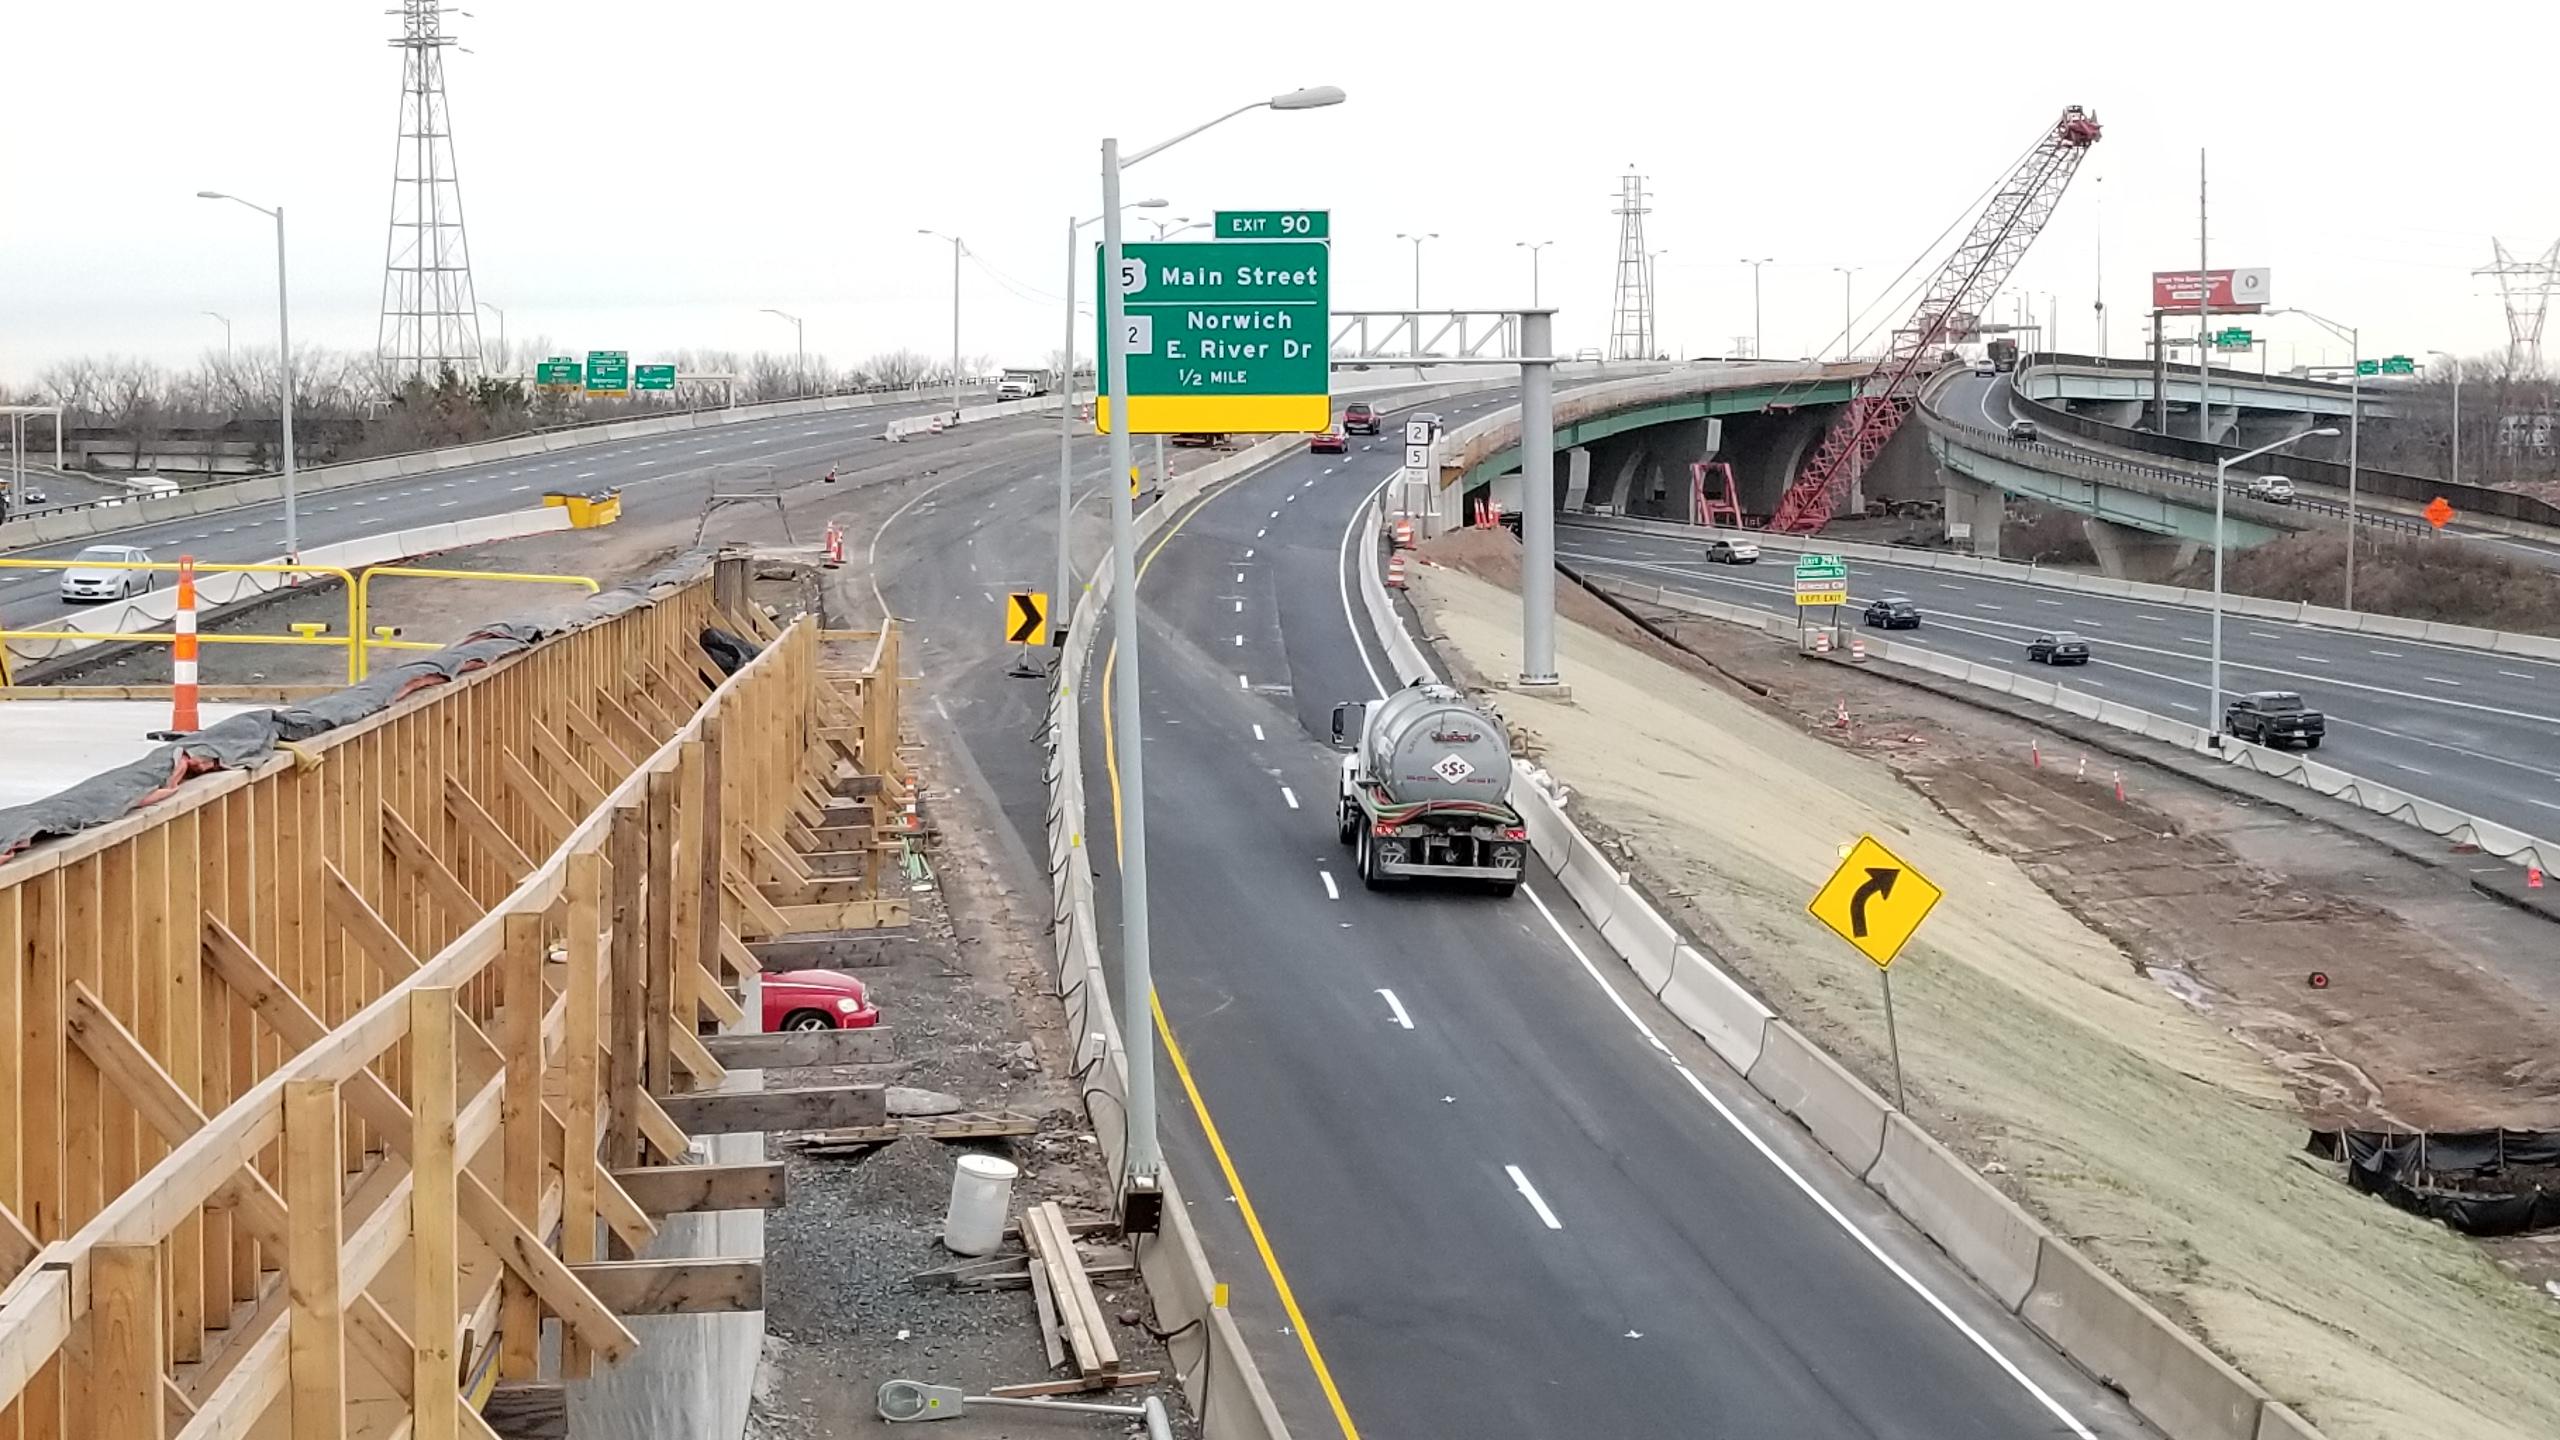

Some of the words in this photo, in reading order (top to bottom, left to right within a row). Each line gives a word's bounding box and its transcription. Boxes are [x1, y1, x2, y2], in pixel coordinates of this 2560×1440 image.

[1233, 218, 1266, 232] EXIT
[1281, 216, 1311, 234] 90
[1121, 267, 1135, 287] 5
[1162, 267, 1223, 285] Main
[1237, 266, 1318, 286] Street
[1188, 311, 1292, 330] Norwich
[1128, 327, 1138, 344] 2
[1167, 340, 1186, 359] E.
[1201, 339, 1269, 359] River
[1284, 339, 1312, 359] Dr
[1211, 370, 1247, 384] MILE
[1413, 426, 1422, 439] 2
[1413, 450, 1421, 463] 5
[1824, 594, 1841, 602] EXIT
